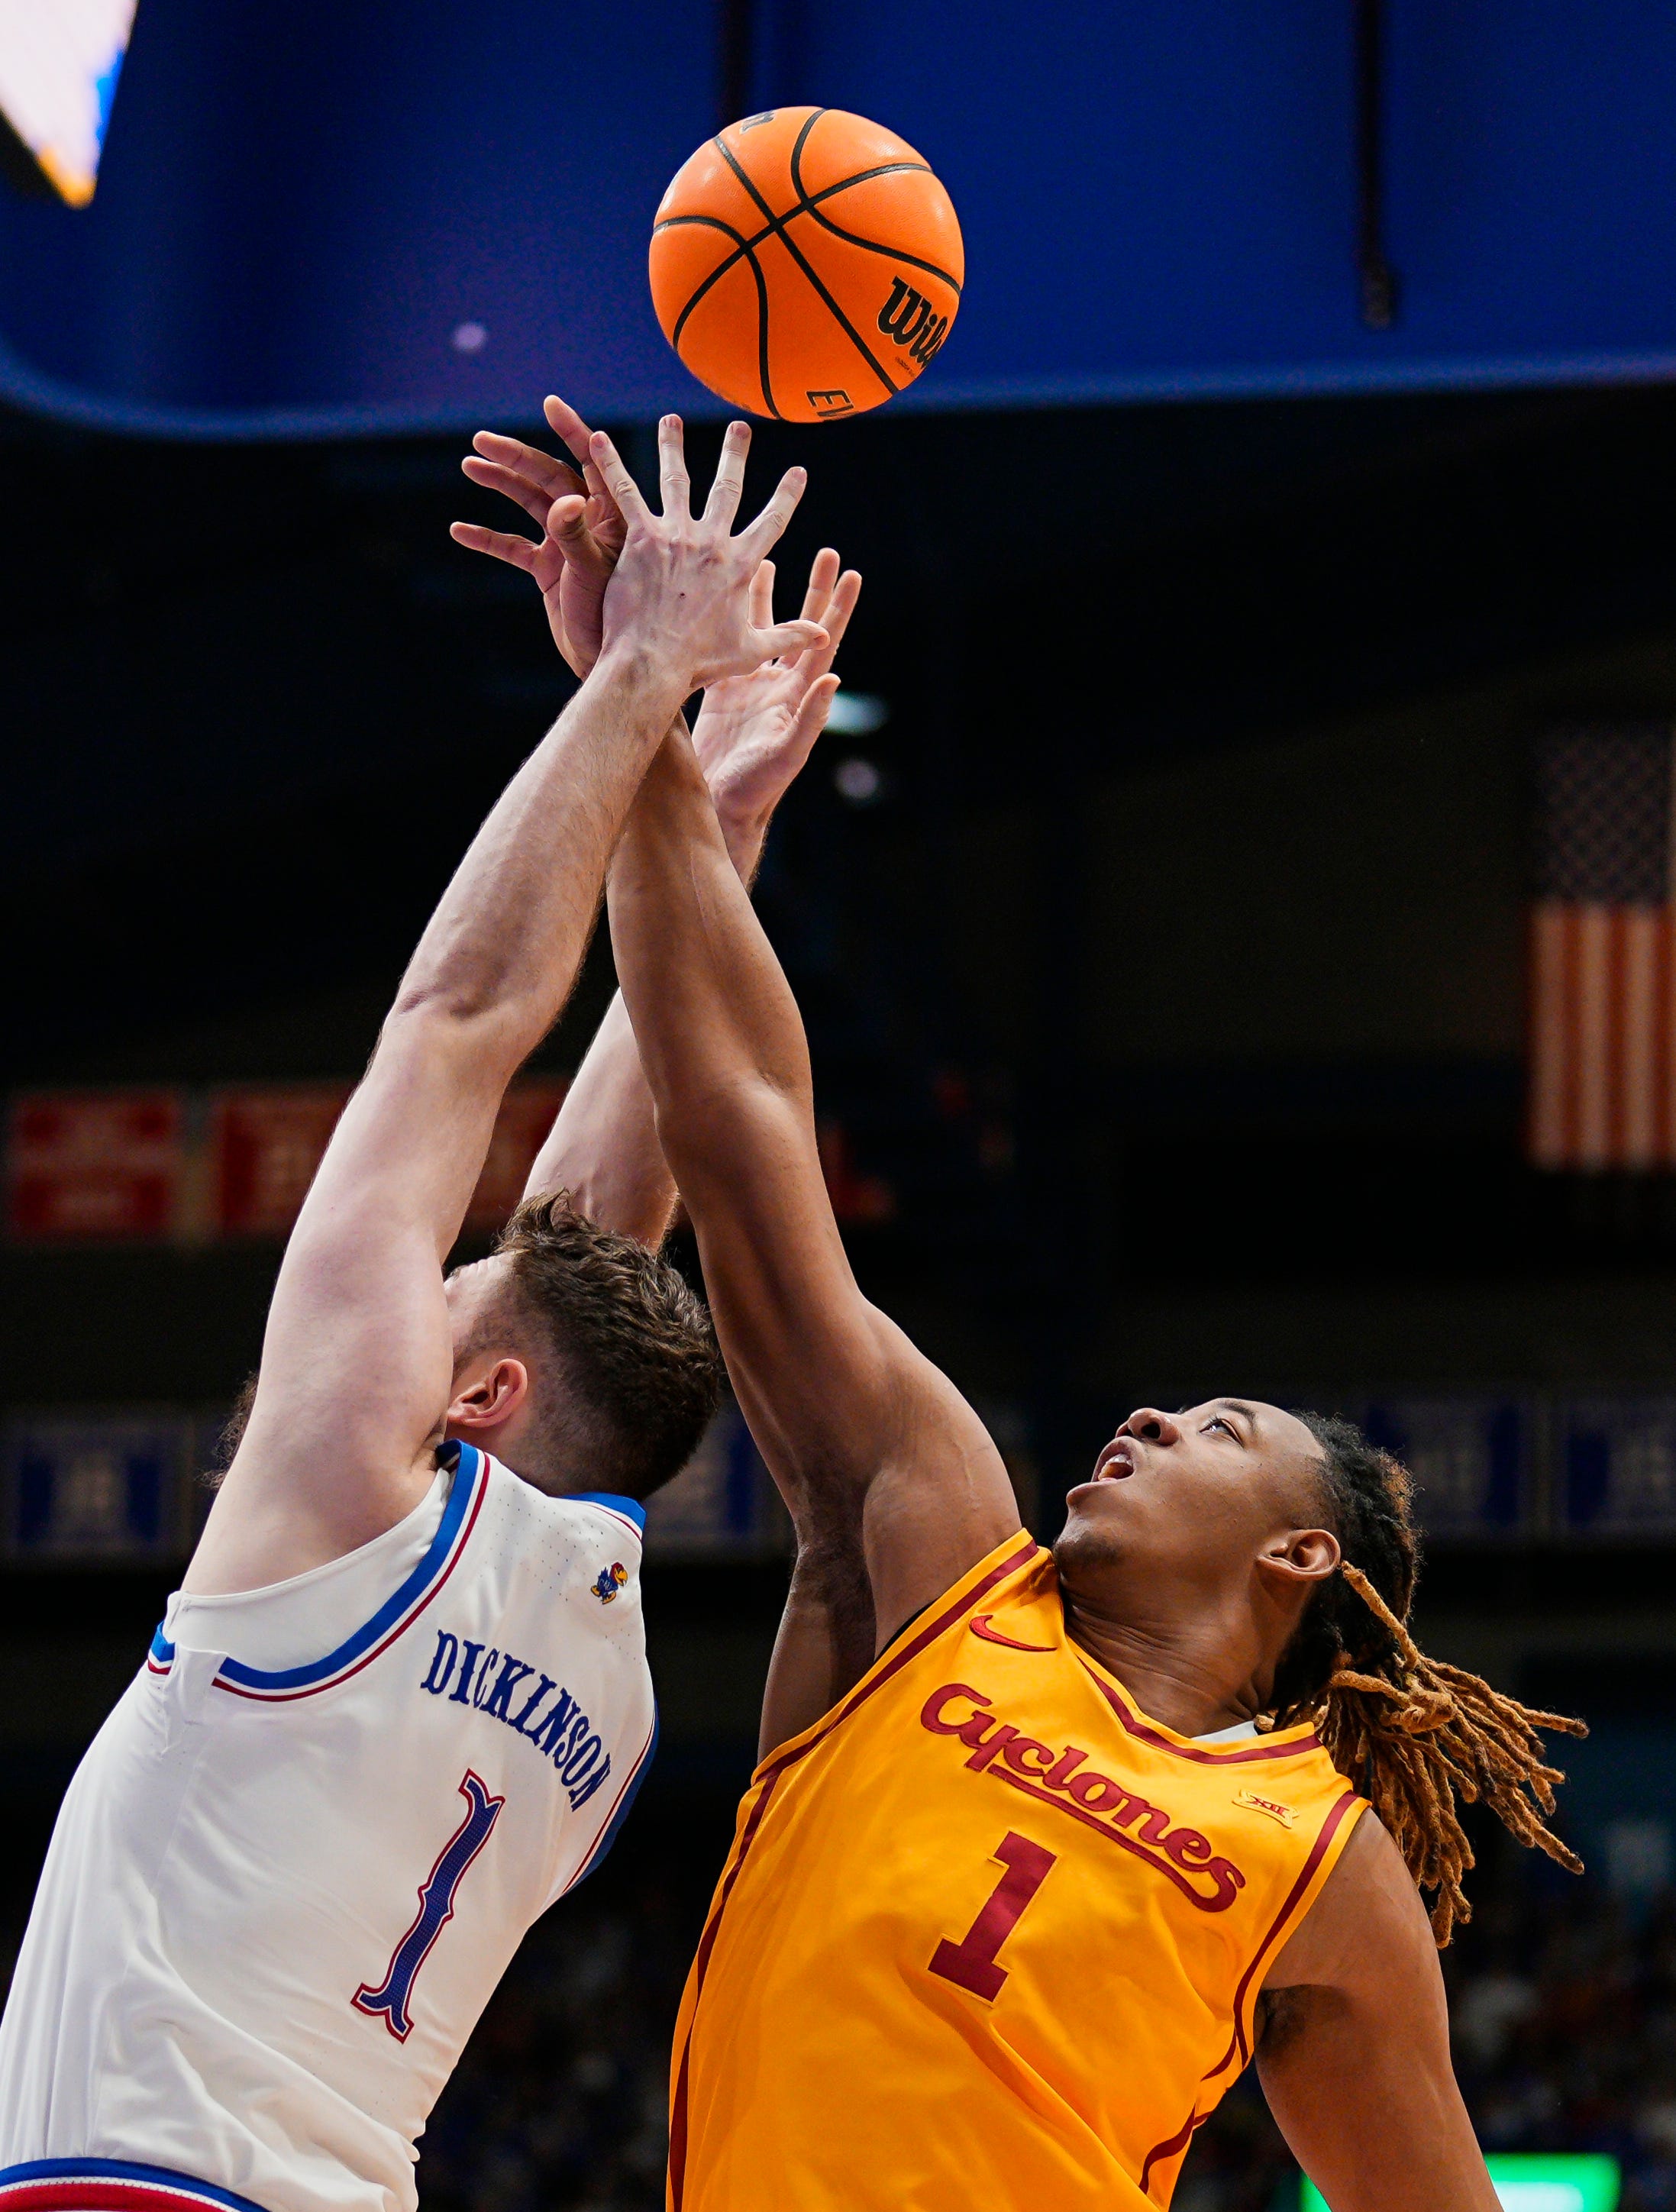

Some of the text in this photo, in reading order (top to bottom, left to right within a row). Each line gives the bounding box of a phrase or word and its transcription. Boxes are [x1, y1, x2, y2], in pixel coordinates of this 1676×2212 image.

[420, 1629, 611, 1812] DICKINSON
[920, 1682, 1246, 1913] Cyclones
[350, 1768, 505, 2044] 1
[927, 1828, 1060, 2007] 1
